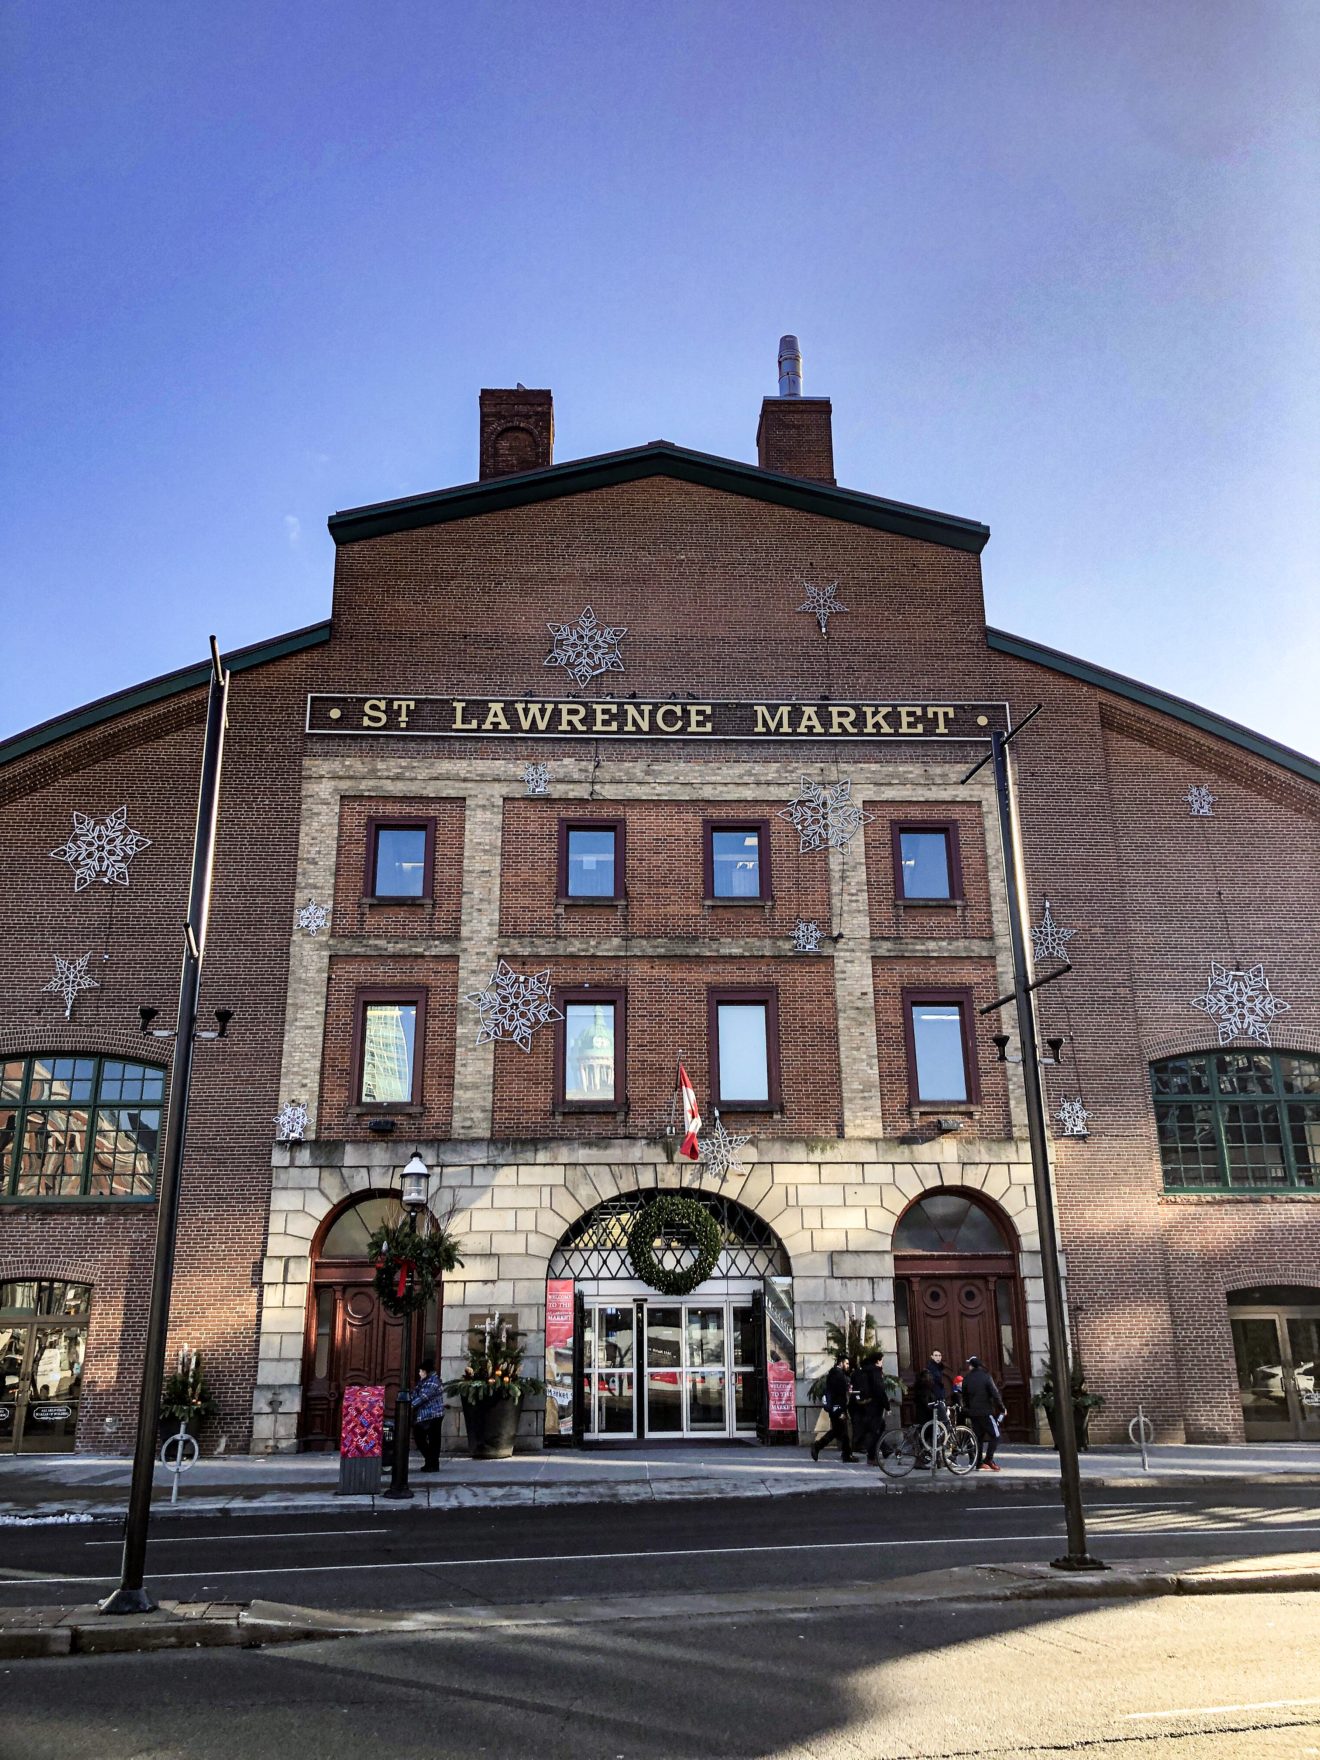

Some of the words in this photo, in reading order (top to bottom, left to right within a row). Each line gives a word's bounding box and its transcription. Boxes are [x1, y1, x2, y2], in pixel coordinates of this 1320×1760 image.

[451, 701, 713, 733] LAWRENCE
[753, 705, 955, 734] MARKET
[547, 1388, 569, 1399] Market
